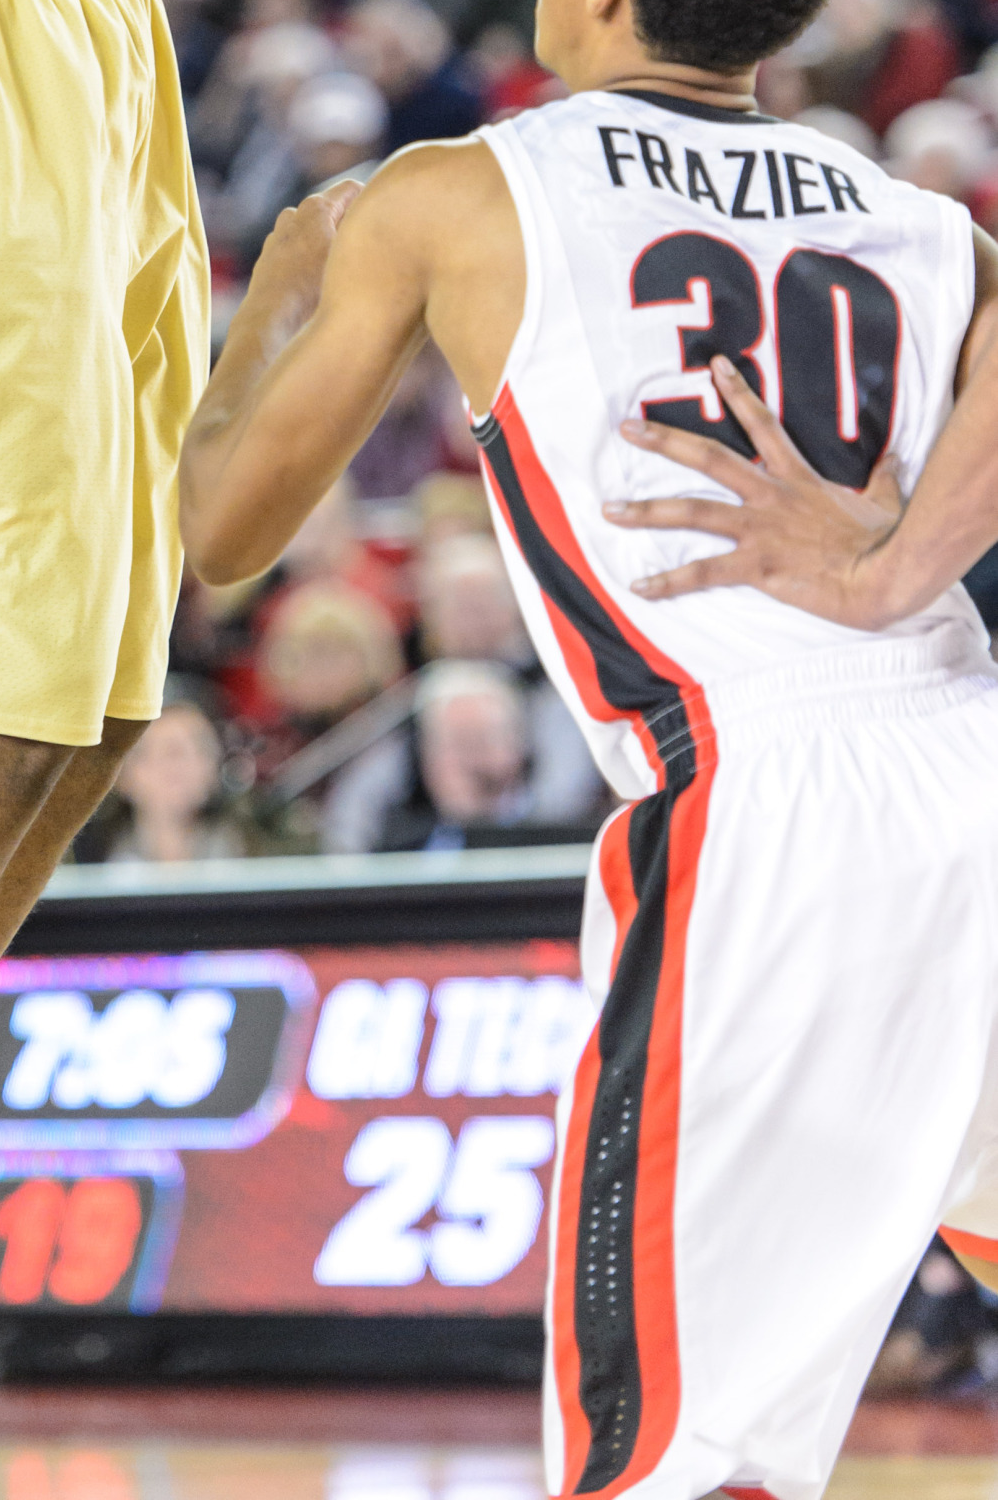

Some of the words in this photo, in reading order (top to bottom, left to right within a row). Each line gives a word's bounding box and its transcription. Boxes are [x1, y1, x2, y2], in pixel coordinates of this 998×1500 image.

[598, 126, 870, 219] FRAZIER
[630, 229, 900, 494] 30
[312, 1114, 556, 1287] 25
